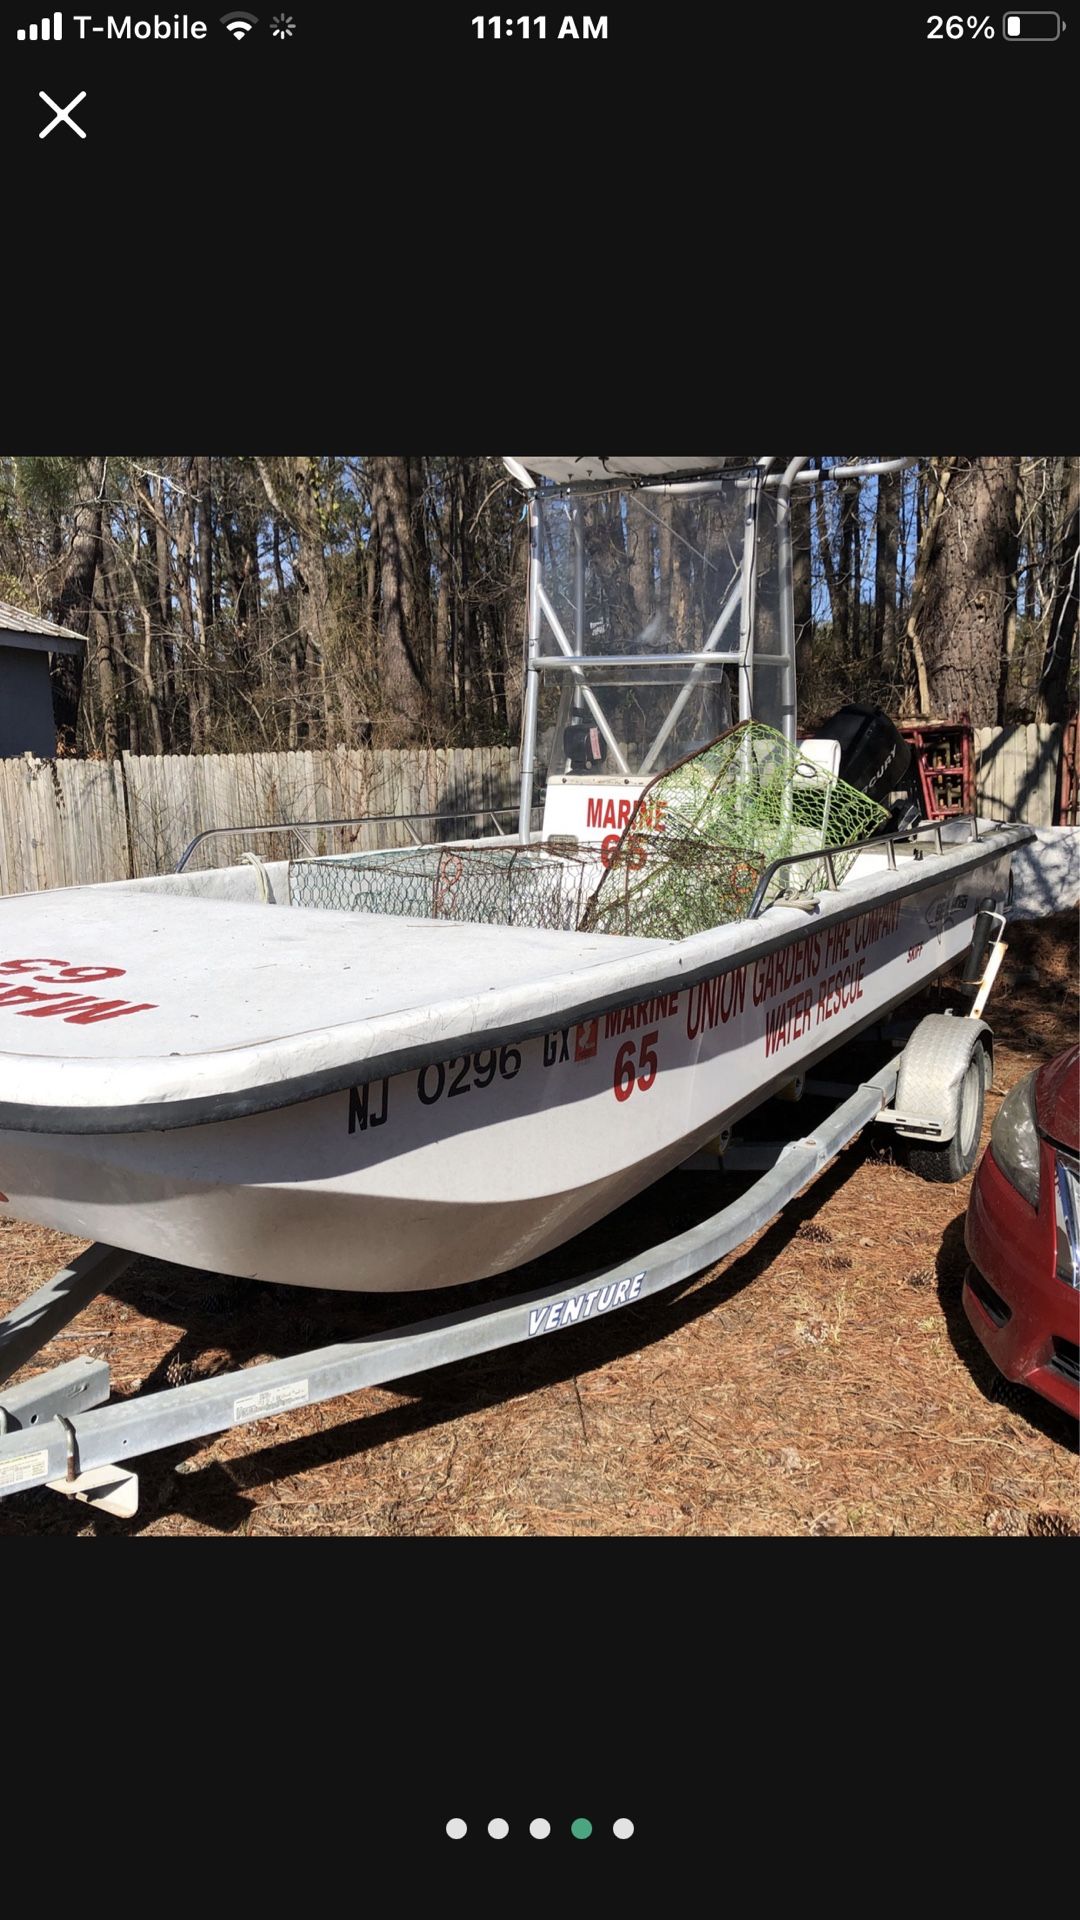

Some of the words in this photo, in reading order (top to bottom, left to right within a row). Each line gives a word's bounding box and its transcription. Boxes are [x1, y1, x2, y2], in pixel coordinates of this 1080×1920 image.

[605, 992, 679, 1039] MARINE
[687, 966, 748, 1041] UNION
[752, 933, 822, 1007] GARDENS
[825, 921, 851, 969] FIRE
[765, 987, 814, 1058] WATER
[816, 957, 866, 1025] RESCUE
[348, 1076, 389, 1134] NJ
[417, 1043, 522, 1105] 0296
[614, 1011, 659, 1102] 65
[528, 1270, 647, 1336] VENTURE
